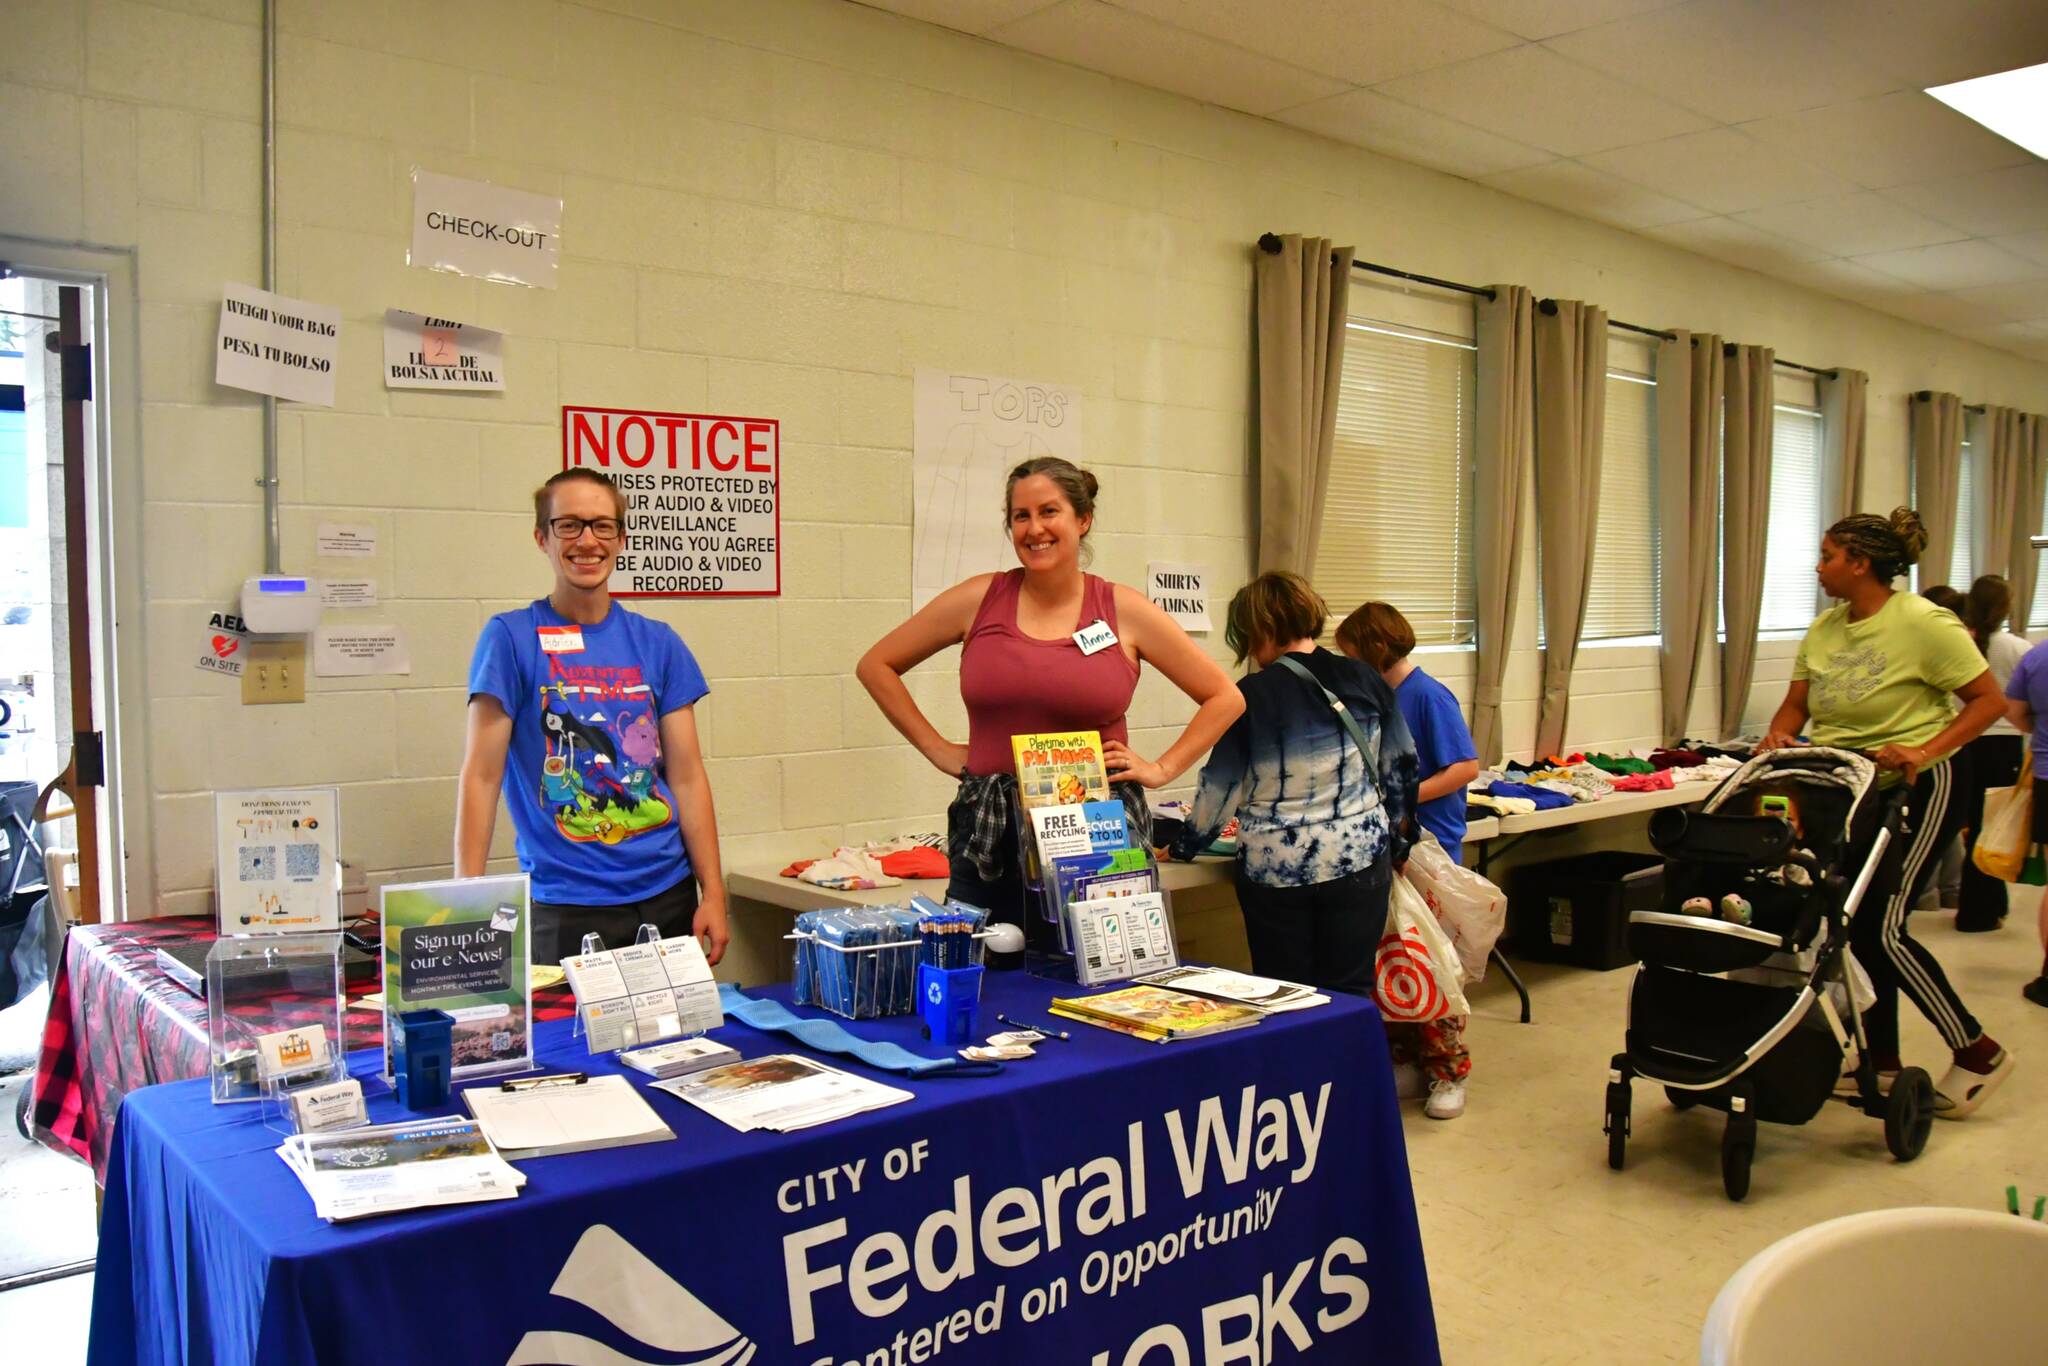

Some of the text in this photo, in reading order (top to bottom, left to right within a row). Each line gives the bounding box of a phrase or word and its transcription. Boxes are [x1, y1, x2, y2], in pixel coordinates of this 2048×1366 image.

[426, 211, 547, 251] CHECK-OUT
[226, 298, 336, 337] WEIGH YOUR BAG
[223, 336, 331, 373] PESA TU BOLSO
[434, 336, 449, 357] 2
[459, 355, 479, 369] DE
[391, 365, 498, 383] BOLSA ACTUAL
[949, 375, 1069, 428] TOPS
[572, 413, 772, 473] NOTICE
[604, 473, 777, 495] MISES PROTECTED BY
[655, 495, 706, 512] AUDIO
[710, 497, 723, 512] &
[727, 497, 773, 514] VIDEO
[627, 514, 737, 532] URVEILLANCE
[625, 535, 775, 553] TERING YOU AGREE
[615, 555, 762, 572] BE AUDIO & VIDEO
[632, 575, 723, 592] RECORDED
[1155, 572, 1201, 591] SHIRTS
[1079, 631, 1114, 650] Annie
[199, 656, 241, 673] ON SITE
[1029, 735, 1086, 750] Playtime with
[1044, 814, 1077, 830] FREE
[1087, 820, 1122, 832] ECYCLE
[1040, 827, 1087, 840] RECYCLING
[1094, 830, 1110, 841] TO
[1112, 830, 1124, 840] 10
[414, 927, 499, 953] Sign up for
[410, 956, 439, 970] our
[776, 1138, 930, 1214] CITY OF
[782, 1081, 1333, 1346] Federal Way
[808, 1185, 1284, 1366] ntered on Opportunity
